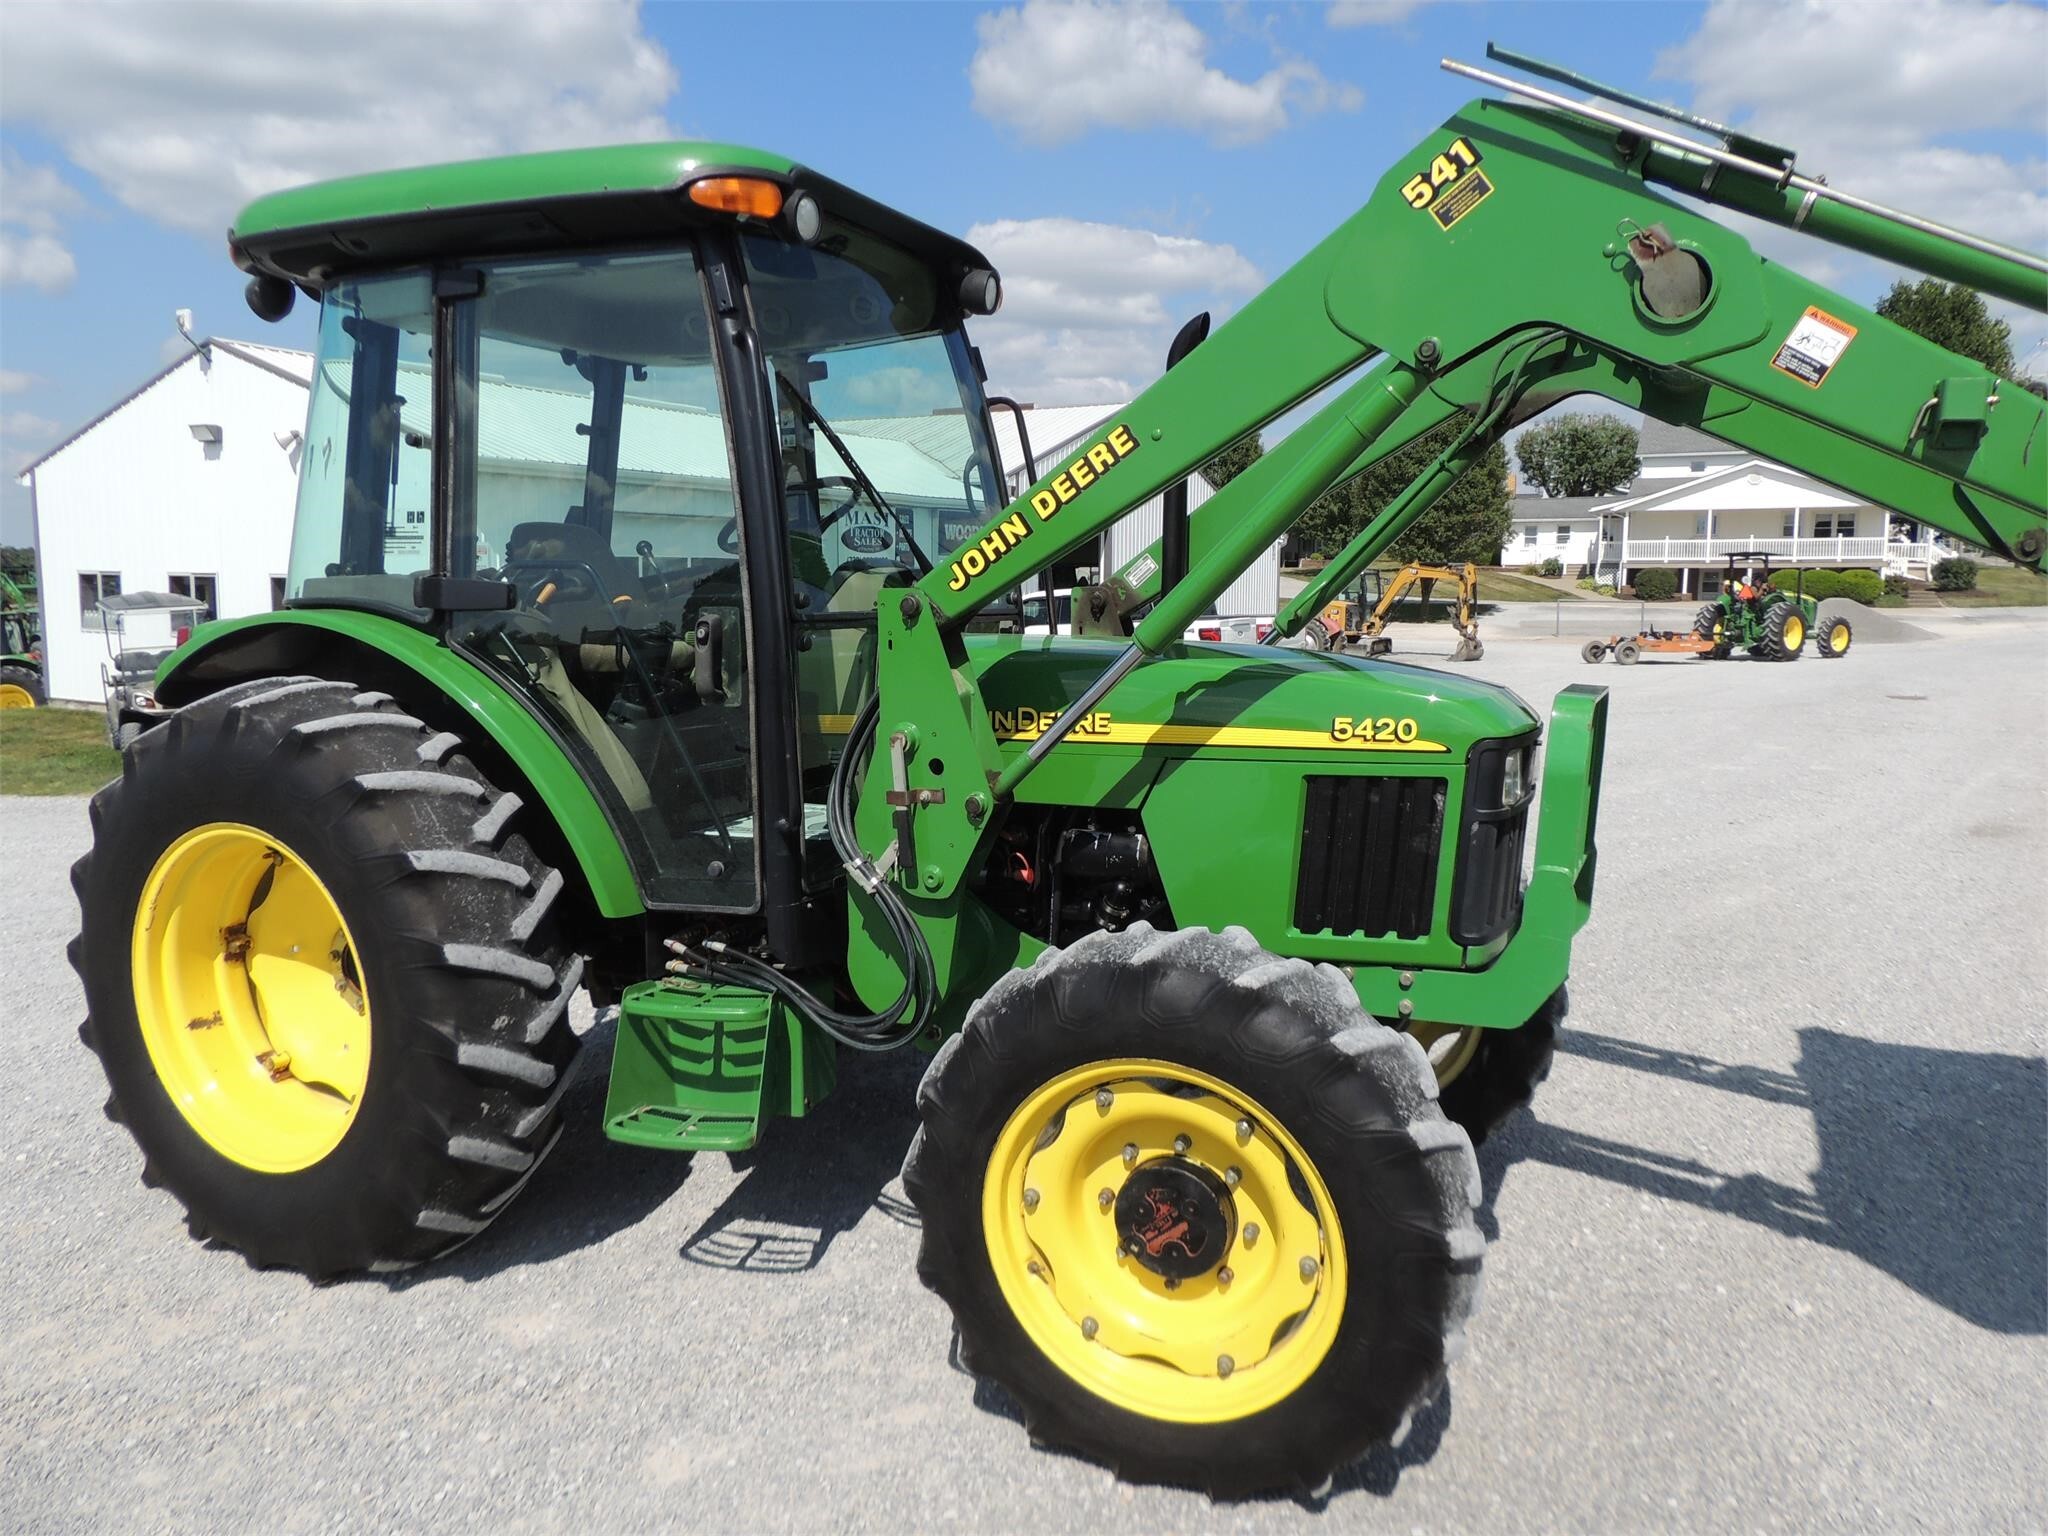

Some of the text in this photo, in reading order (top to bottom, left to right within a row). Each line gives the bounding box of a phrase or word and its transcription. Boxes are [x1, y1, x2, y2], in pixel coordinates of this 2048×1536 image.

[1400, 137, 1478, 210] 541
[948, 424, 1138, 592] JOHN DEERE
[850, 526, 884, 537] TRACTOR
[854, 537, 882, 546] SALES
[1017, 706, 1112, 734] DERE
[1332, 717, 1418, 742] 5420
